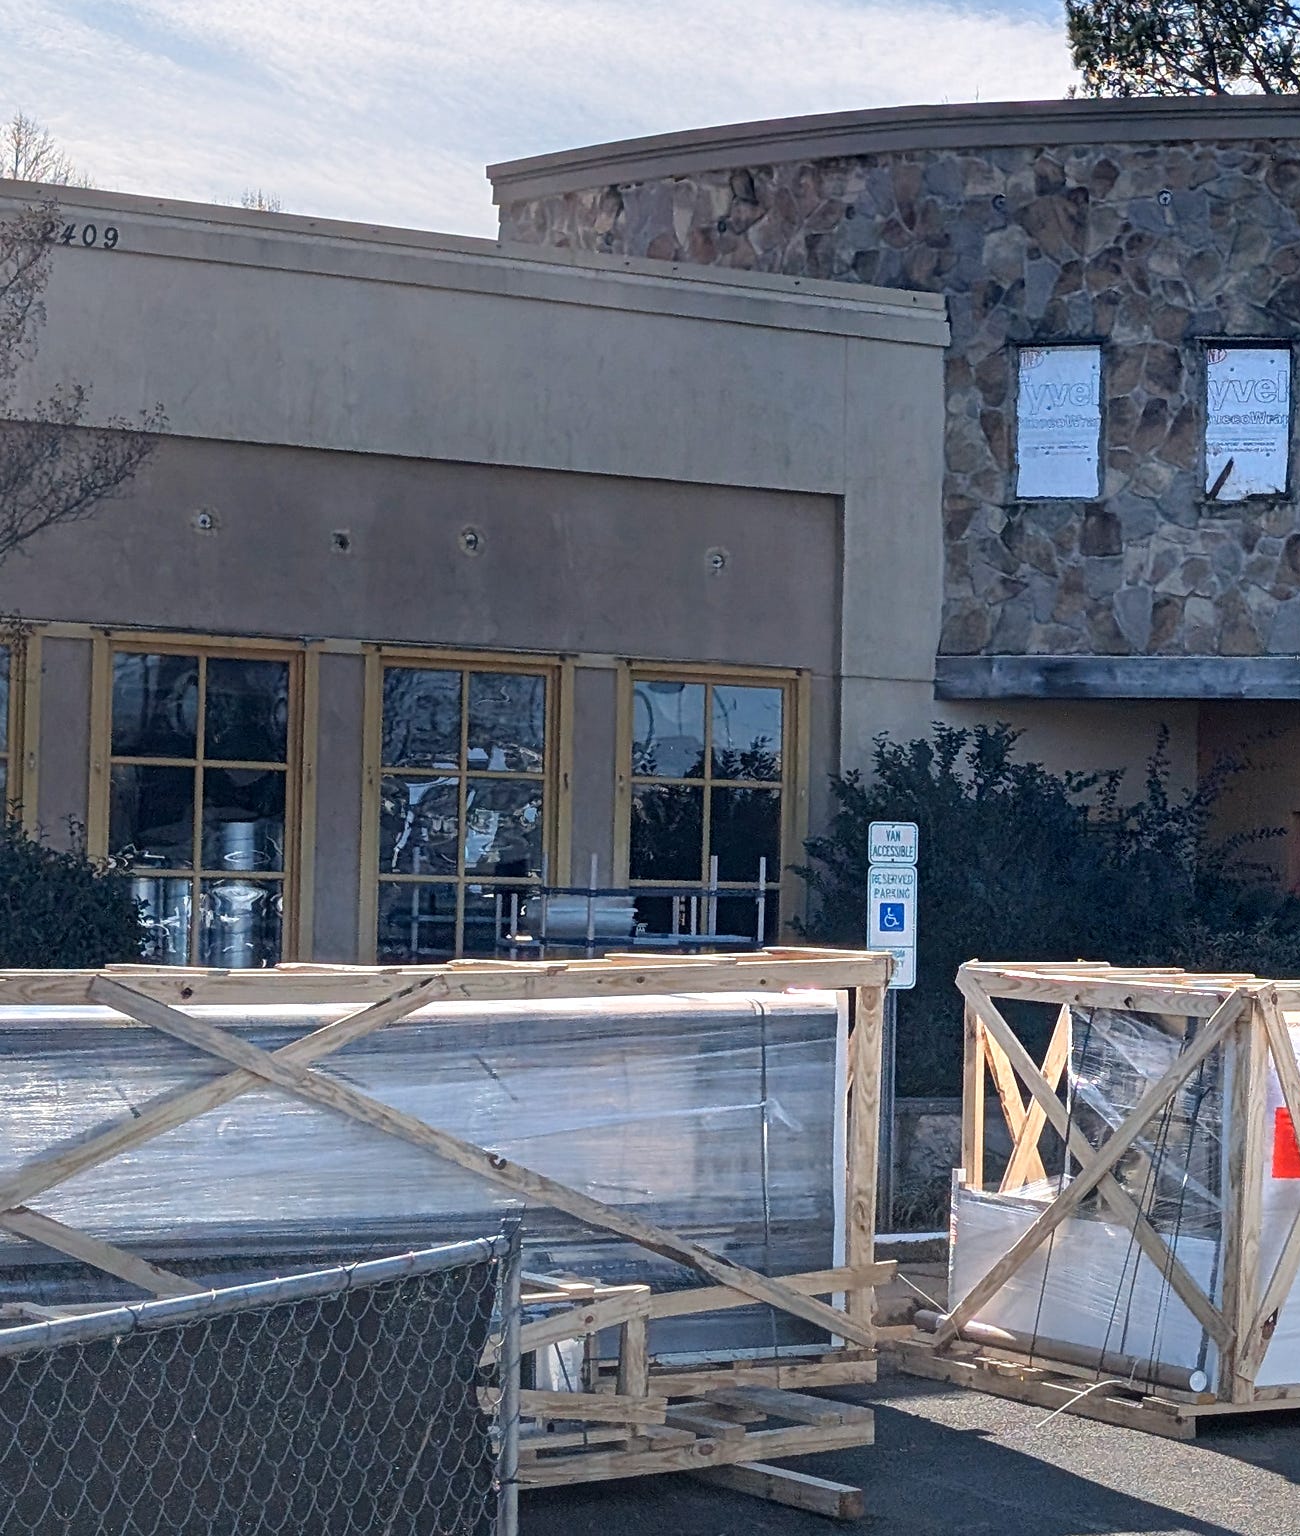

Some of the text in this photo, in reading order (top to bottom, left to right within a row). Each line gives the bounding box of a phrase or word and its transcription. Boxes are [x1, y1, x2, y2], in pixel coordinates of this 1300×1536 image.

[885, 830, 901, 842] VAN
[872, 845, 914, 858] ACCESSIBLE
[871, 873, 914, 885] RESERVED
[874, 887, 911, 900] PARKING
